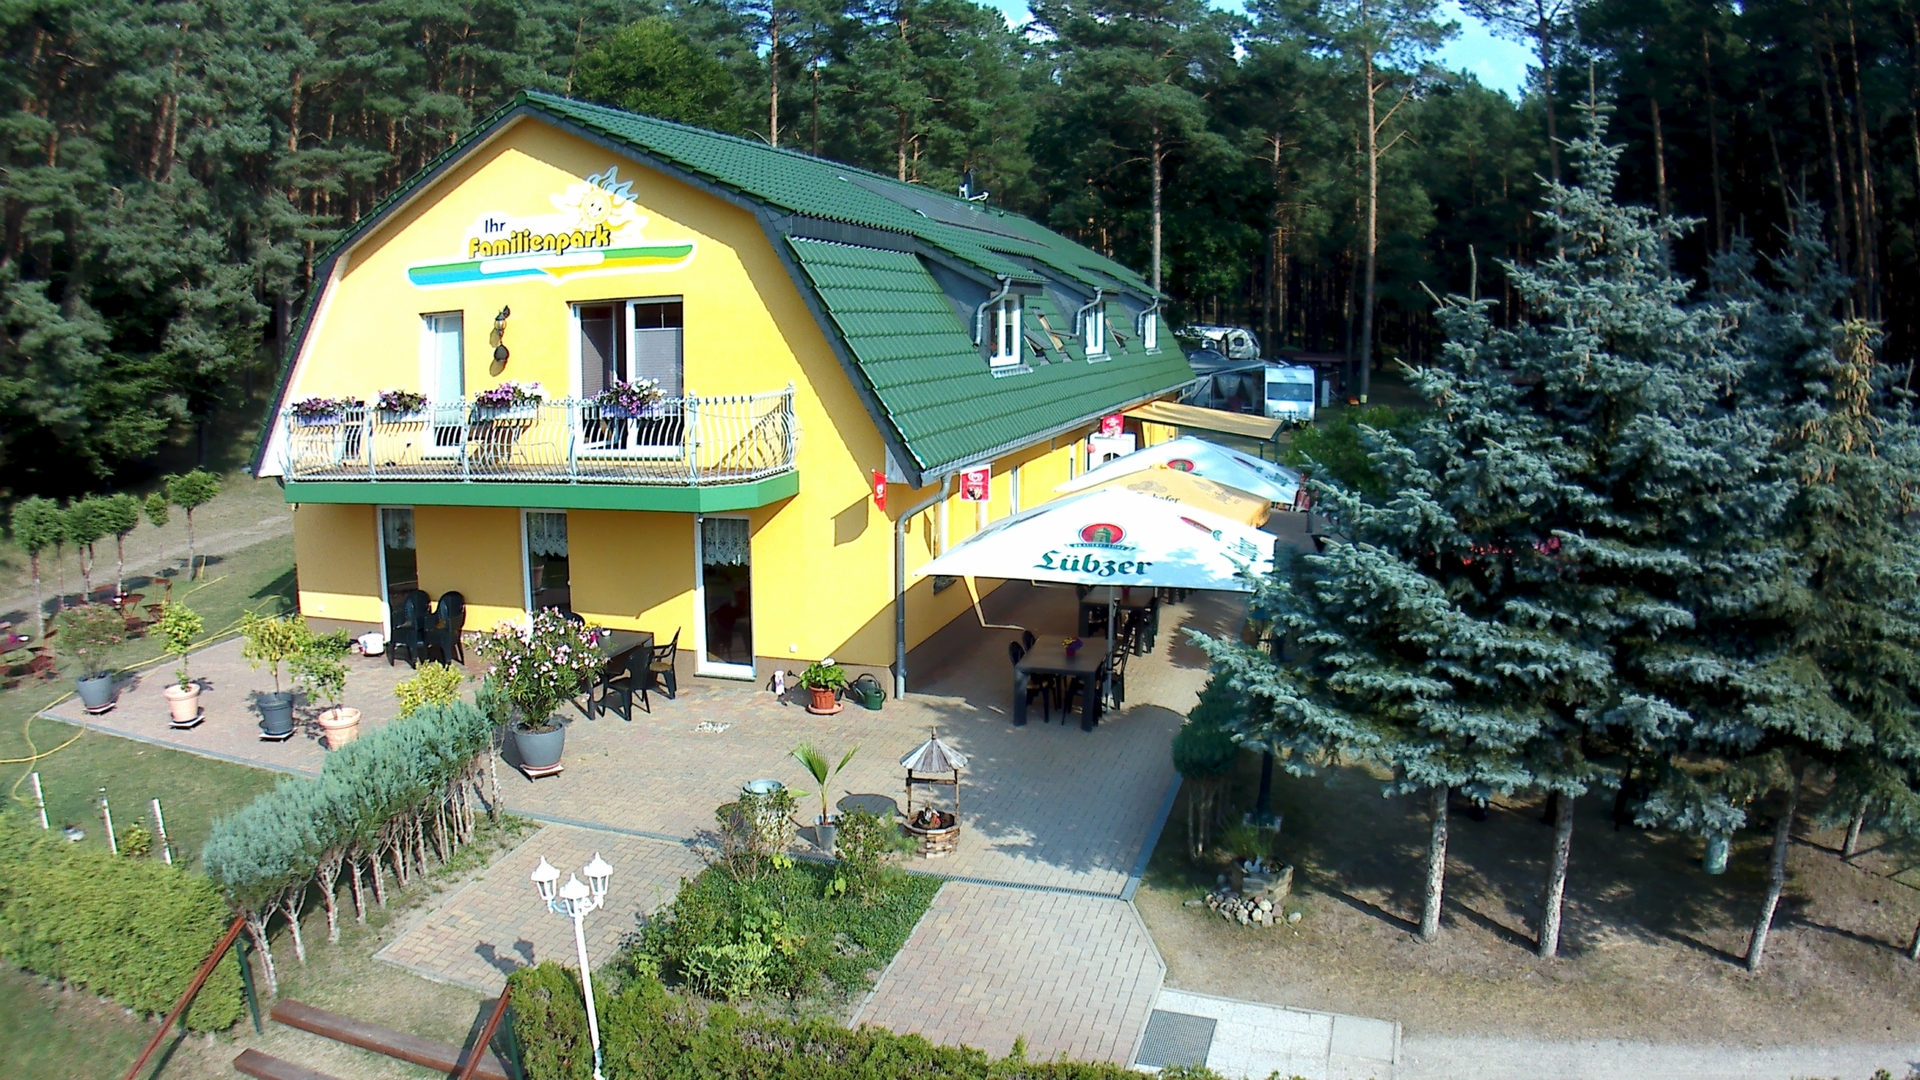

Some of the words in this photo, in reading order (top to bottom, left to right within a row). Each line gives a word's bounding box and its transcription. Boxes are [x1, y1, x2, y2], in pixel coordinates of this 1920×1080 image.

[484, 218, 506, 233] Ihr
[468, 223, 611, 259] Familienpark
[1032, 549, 1154, 578] Lübzer
